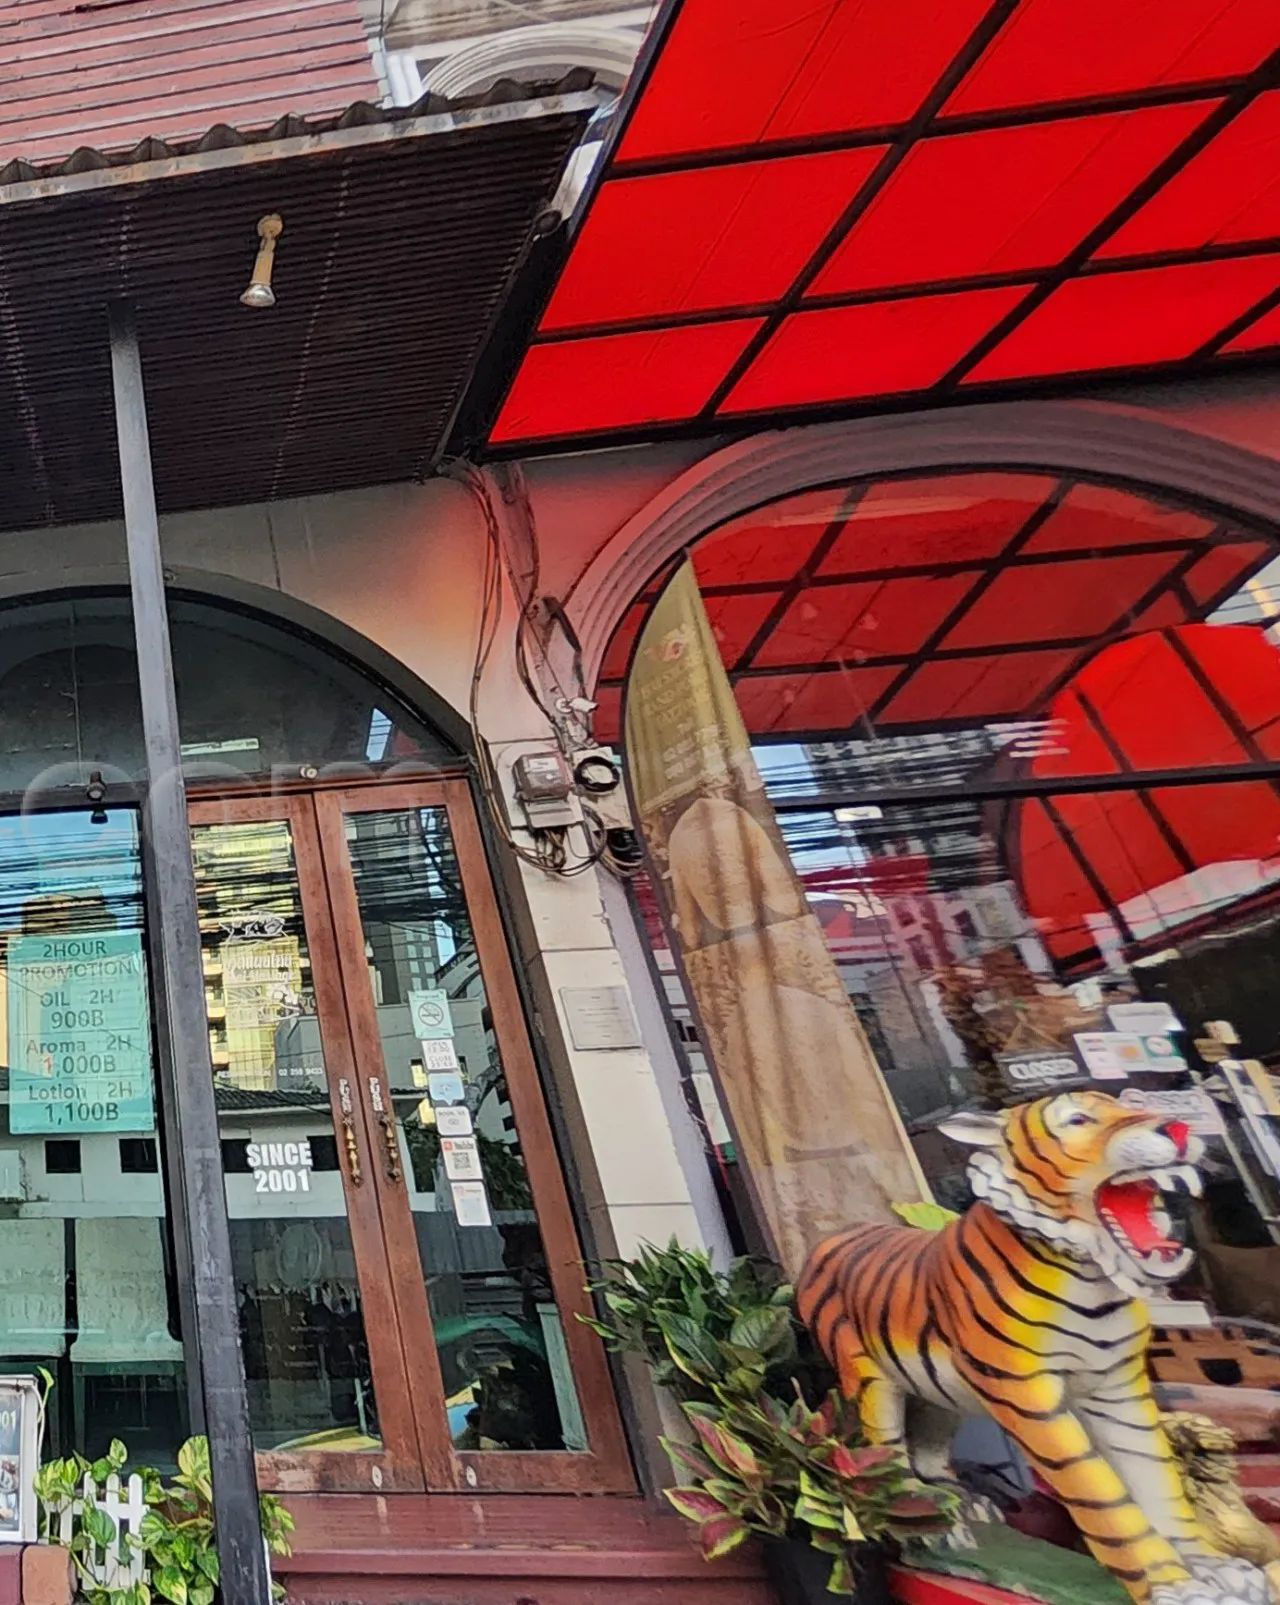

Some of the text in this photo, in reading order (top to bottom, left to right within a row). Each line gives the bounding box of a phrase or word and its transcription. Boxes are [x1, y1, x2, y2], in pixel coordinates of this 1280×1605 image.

[42, 940, 107, 957] 2HOUR
[20, 961, 135, 981] PROMOTION
[40, 989, 114, 1008] OIL 2H
[51, 1010, 105, 1030] 900B
[26, 1035, 133, 1055] Aroma 2H
[42, 1055, 116, 1078] 1,000B
[29, 1082, 133, 1101] Lotion 2H
[44, 1102, 119, 1126] 1,100B
[246, 1141, 313, 1168] SINCE
[254, 1168, 310, 1193] 2001
